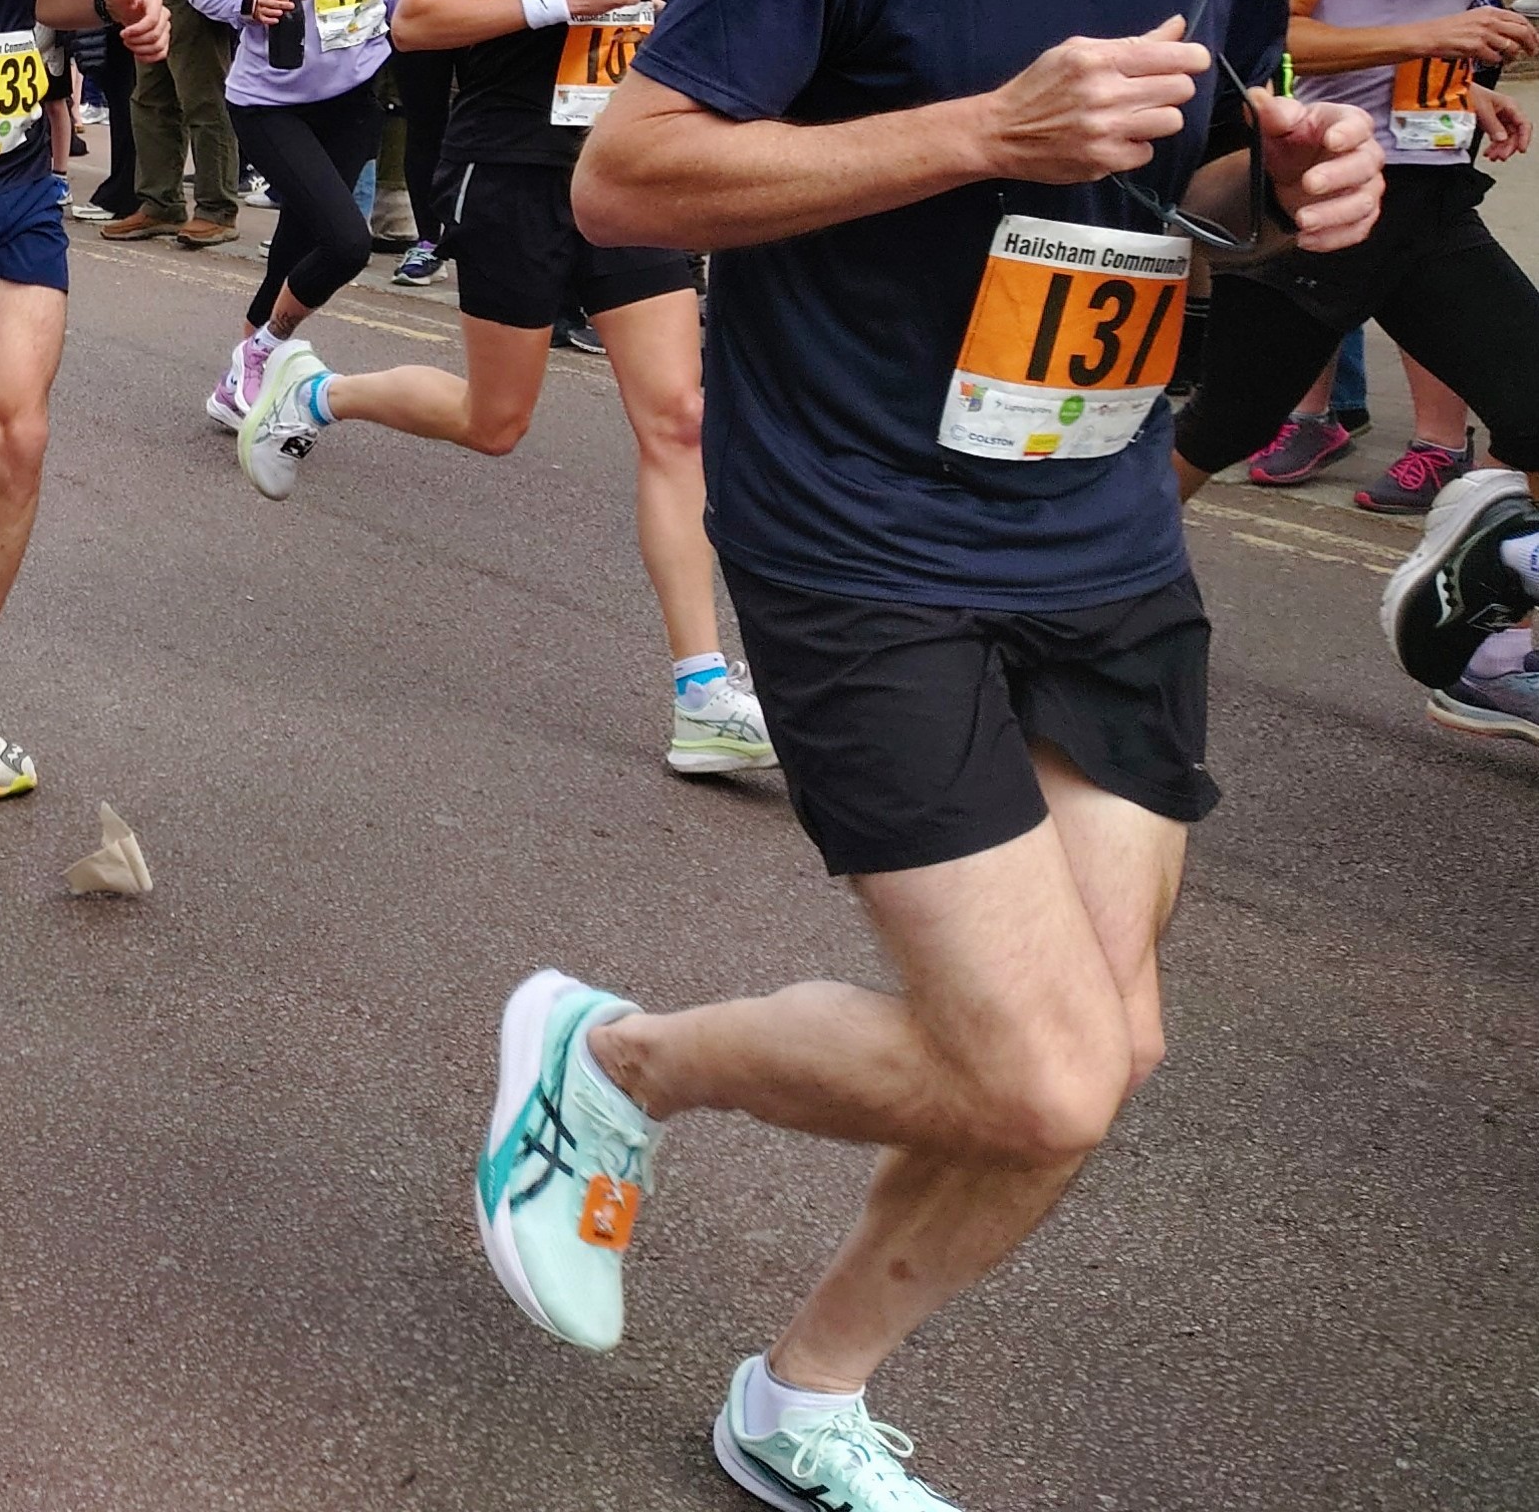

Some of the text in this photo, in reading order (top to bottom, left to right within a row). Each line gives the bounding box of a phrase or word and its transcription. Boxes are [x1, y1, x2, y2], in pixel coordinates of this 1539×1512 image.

[1004, 233, 1188, 277] Hailsham Community
[968, 432, 1015, 447] COLSTON
